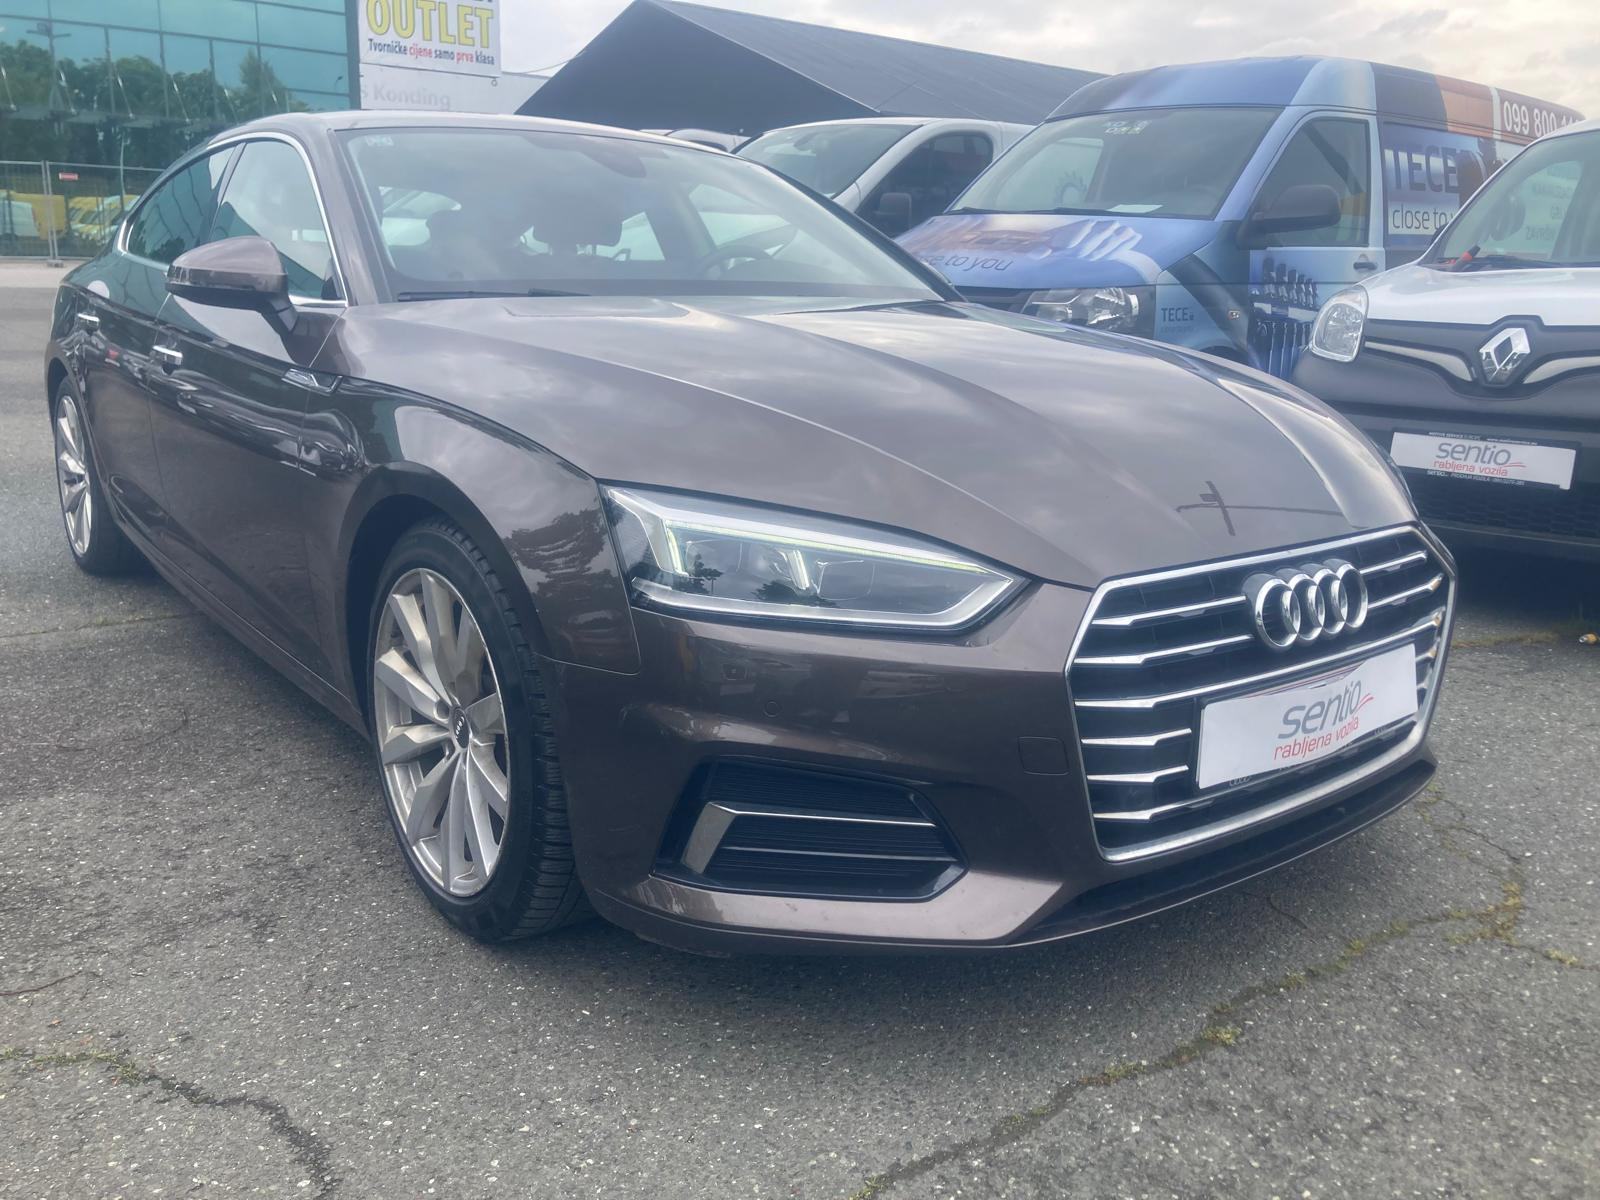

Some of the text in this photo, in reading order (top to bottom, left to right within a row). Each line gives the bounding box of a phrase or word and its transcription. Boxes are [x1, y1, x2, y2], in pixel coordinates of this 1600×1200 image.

[366, 0, 495, 48] OUTLET
[367, 38, 495, 65] Tvorničke cijene samo prva klasa
[373, 82, 449, 108] Konding
[1503, 101, 1530, 135] 099
[1533, 108, 1557, 137] 800
[1383, 143, 1459, 194] TECE
[1392, 203, 1447, 230] close to
[944, 254, 967, 266] to
[967, 256, 1014, 272] you
[1161, 307, 1189, 322] TECE
[1435, 442, 1511, 466] sentio
[1433, 460, 1508, 477] rabljena vozila
[1278, 680, 1362, 739] sentio
[1274, 715, 1359, 761] rabljena vozila
